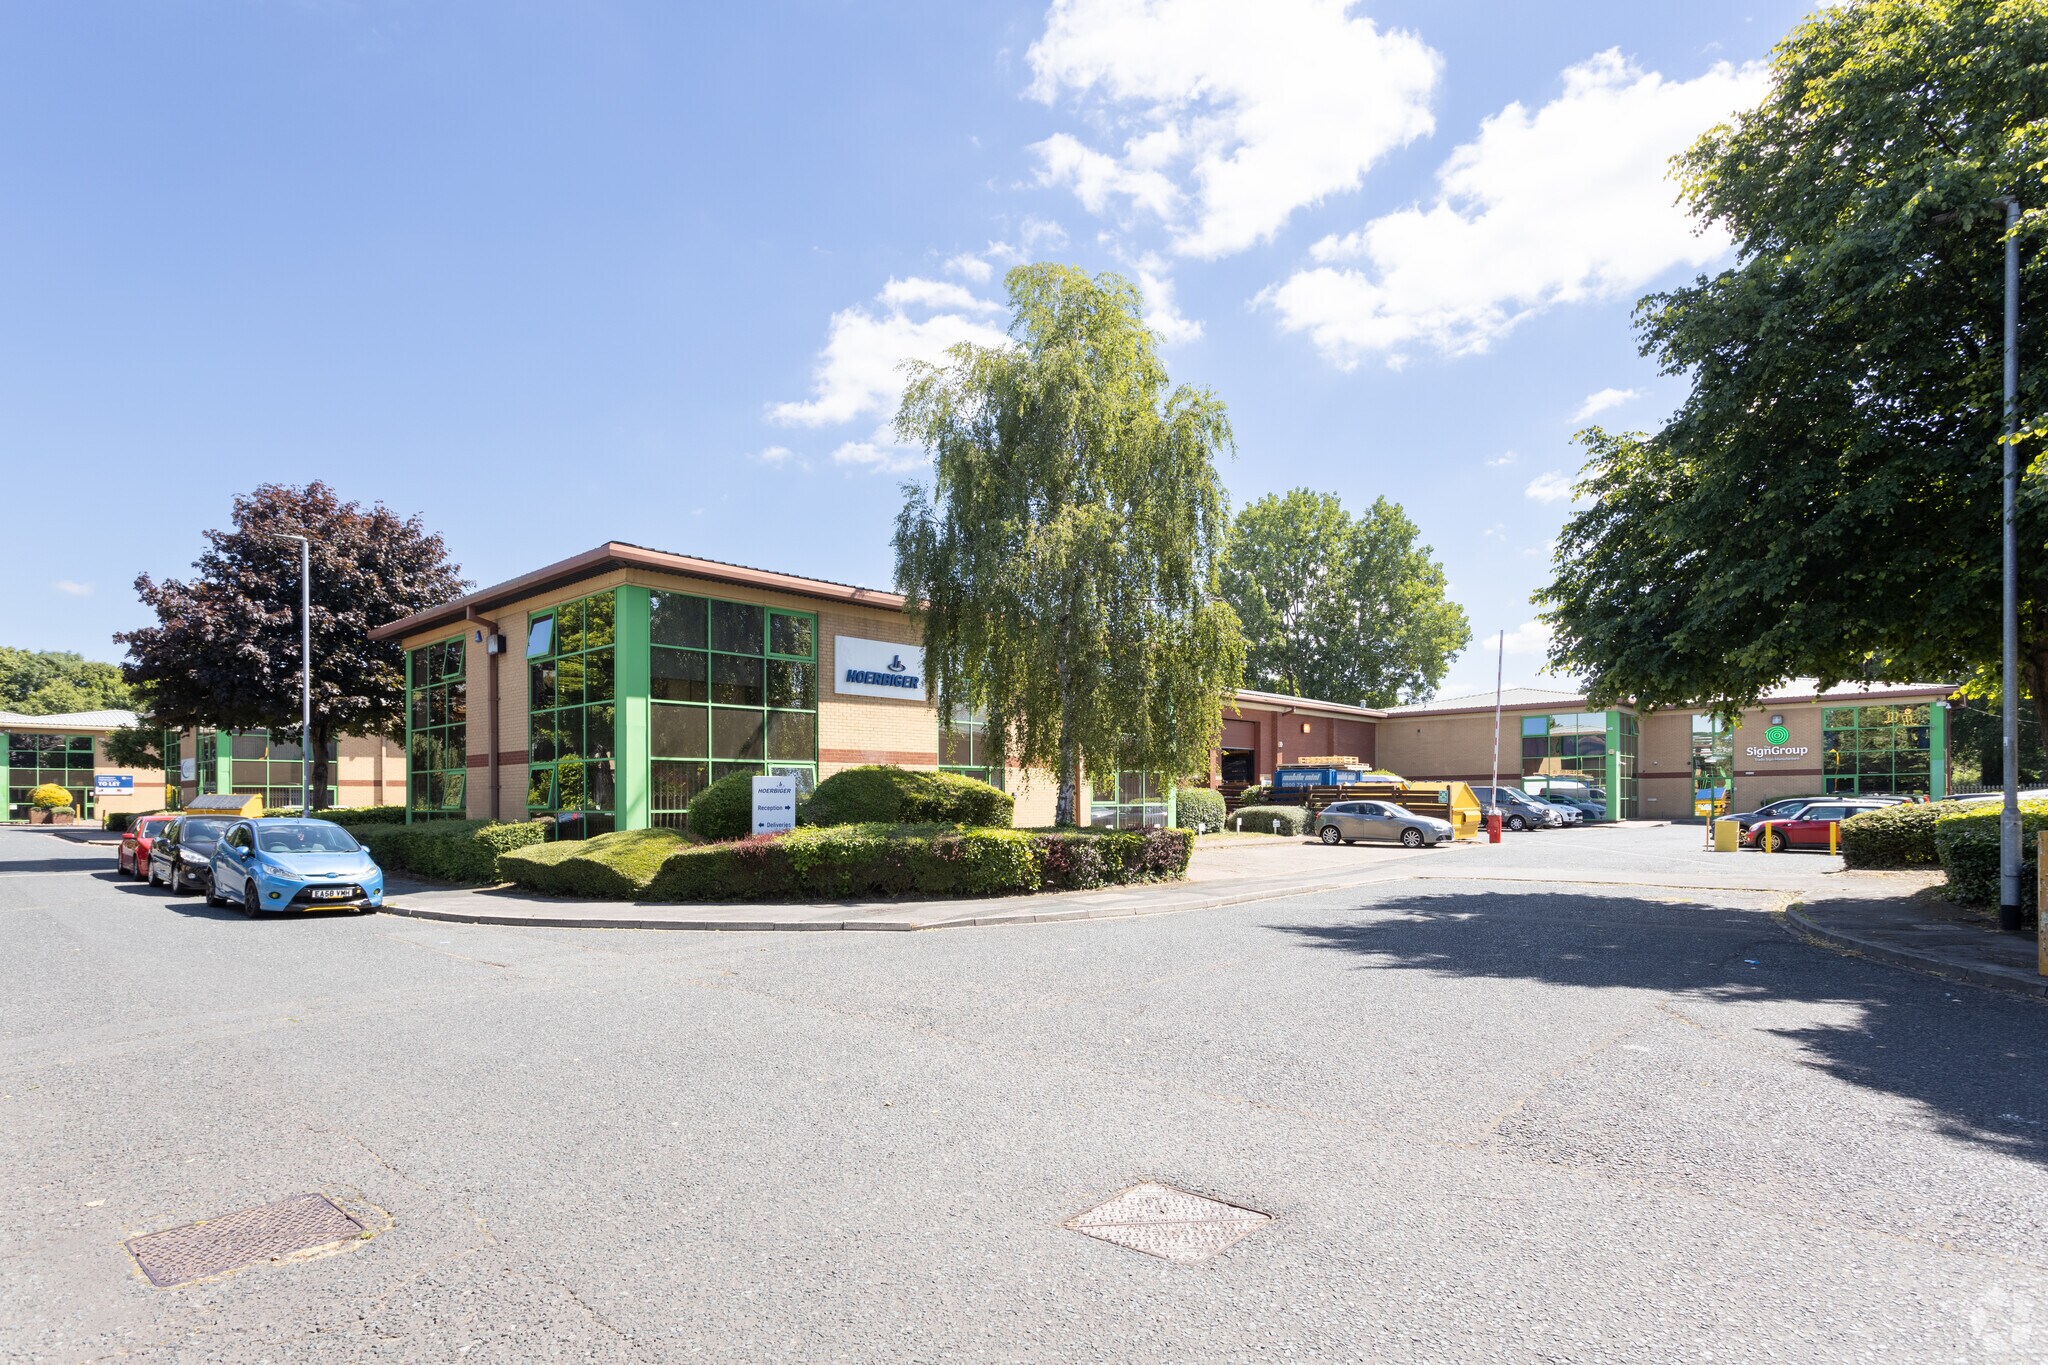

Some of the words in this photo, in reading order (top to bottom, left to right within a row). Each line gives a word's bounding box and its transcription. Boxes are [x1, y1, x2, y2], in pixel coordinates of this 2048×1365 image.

[846, 669, 919, 689] HOERBIGER
[1746, 746, 1808, 758] SignGroup
[1282, 773, 1304, 781] mobile
